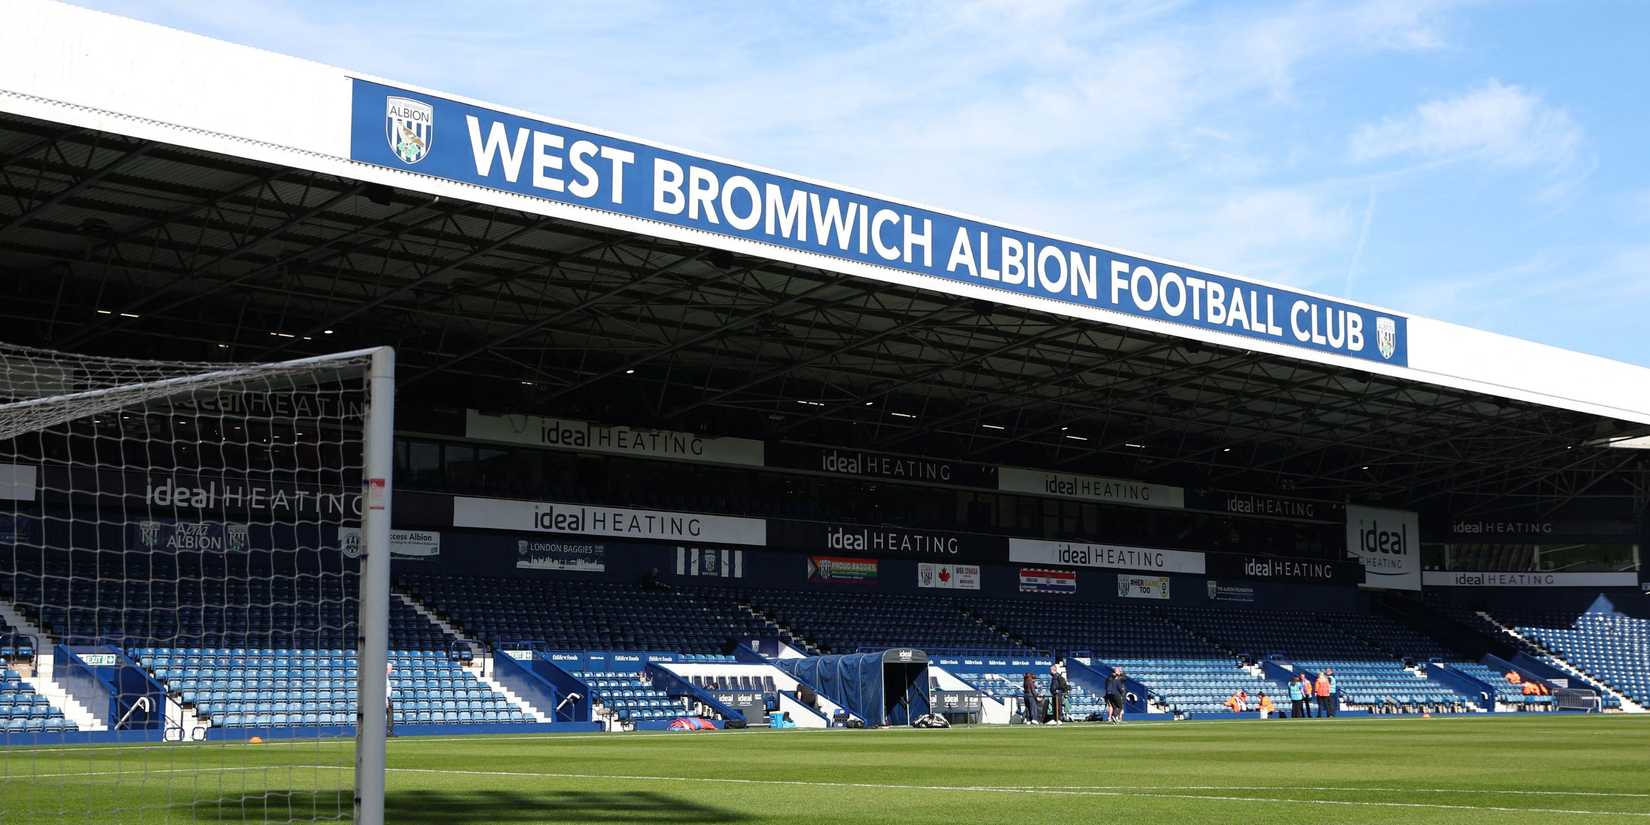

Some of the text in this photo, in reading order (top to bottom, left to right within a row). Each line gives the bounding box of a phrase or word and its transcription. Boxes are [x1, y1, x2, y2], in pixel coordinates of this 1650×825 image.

[389, 104, 430, 123] ALBION
[466, 115, 1364, 352] WEST BROMWICH ALBION FOOTBALL CLUB
[251, 393, 364, 421] HEATIN
[541, 420, 703, 455] ideal HEATING
[822, 450, 951, 480] ideal HEATING
[147, 478, 215, 509] ideal
[1046, 475, 1150, 501] ideal HEATING
[1227, 495, 1313, 518] ideal HEATING
[534, 504, 700, 536] ideal HEATING
[1452, 520, 1552, 534] ideal HEATING
[167, 534, 222, 550] ALBION
[409, 532, 433, 542] Albion
[828, 527, 959, 554] ideal HEATING
[1360, 521, 1407, 555] ideal
[530, 542, 562, 553] LONDON
[563, 544, 593, 555] BAGGIES
[1058, 544, 1164, 568] ideal HEATING
[1245, 559, 1332, 579] ideal HEATING
[1366, 559, 1402, 569] HEATING
[1455, 573, 1554, 585] ideal HEATING
[718, 694, 734, 702] ideal
[737, 694, 752, 702] ideal
[944, 694, 958, 703] ideal
